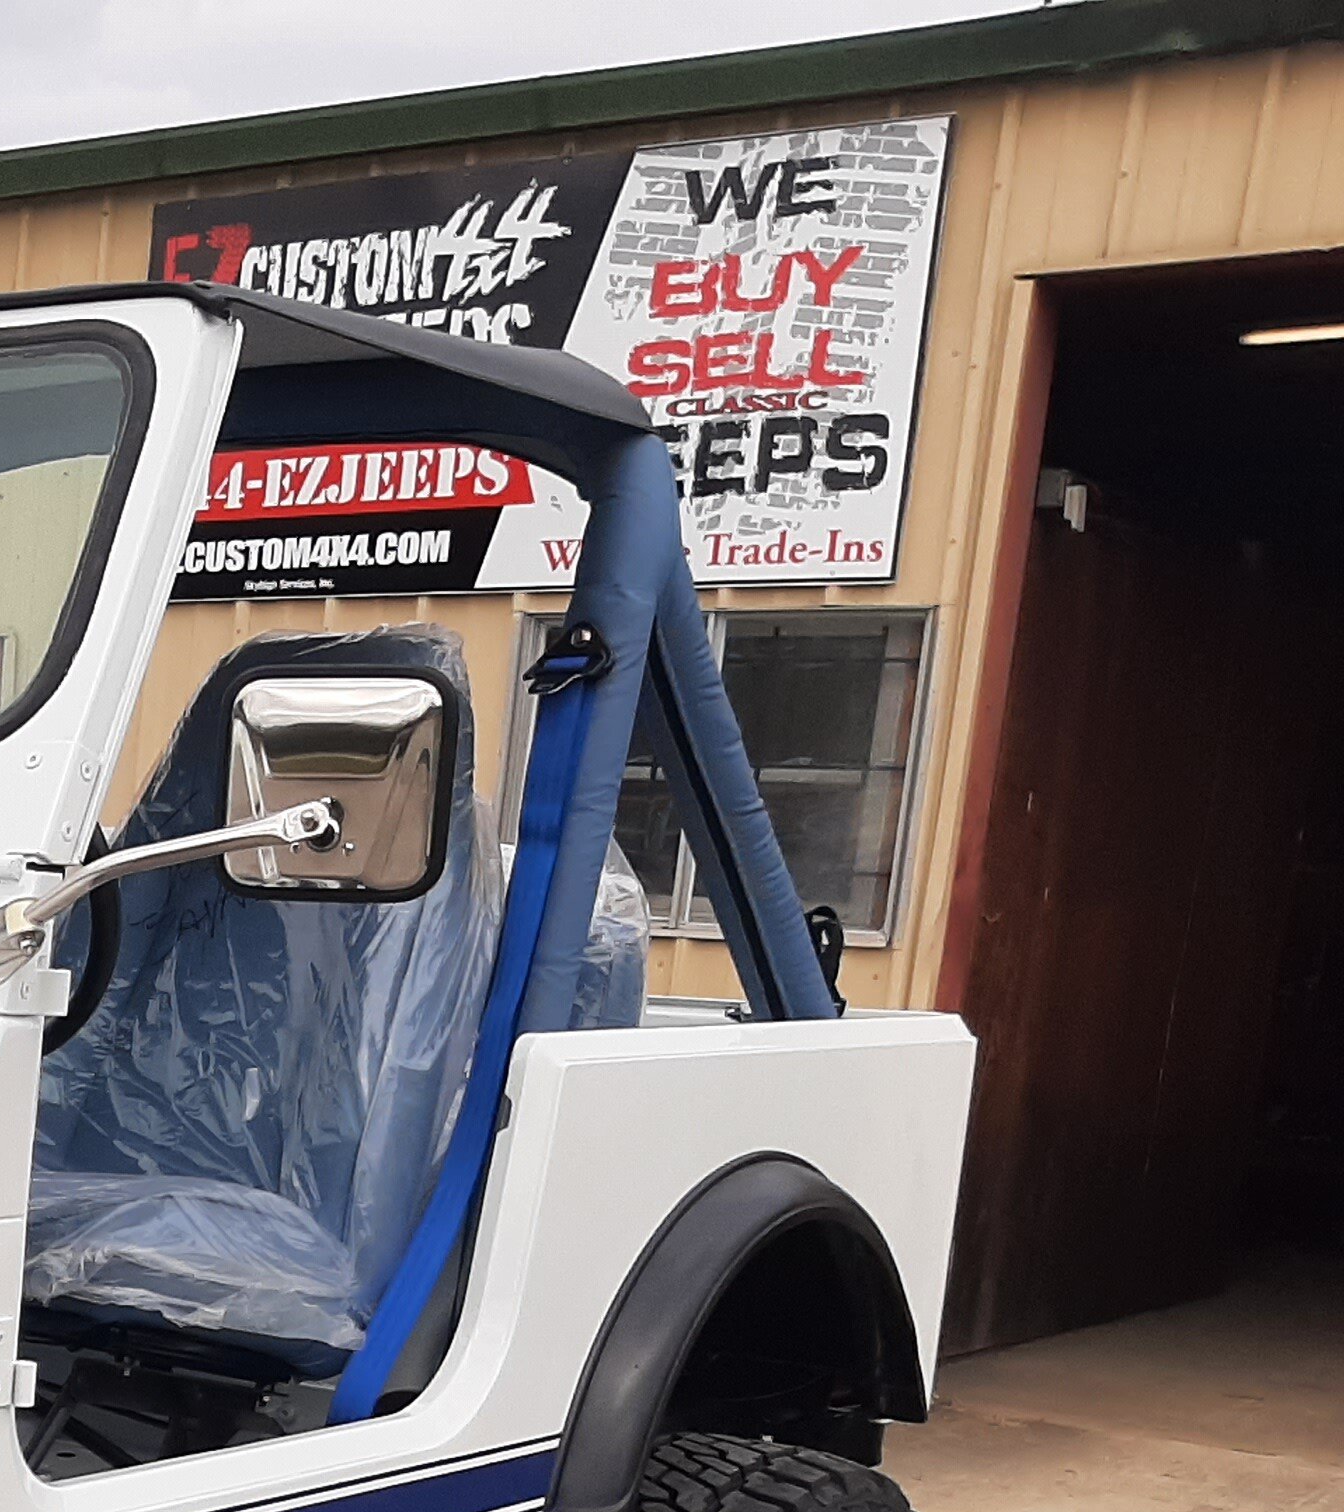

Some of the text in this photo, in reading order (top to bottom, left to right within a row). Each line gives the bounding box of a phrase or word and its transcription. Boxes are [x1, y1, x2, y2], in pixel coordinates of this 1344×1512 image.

[685, 155, 838, 225] WE
[649, 245, 866, 319] BUY
[626, 328, 866, 397] SELL
[666, 391, 828, 417] CLASSIC
[200, 446, 510, 511] 4-EZJEEPS
[657, 412, 889, 498] EEPS
[703, 527, 884, 567] Trade-Ins
